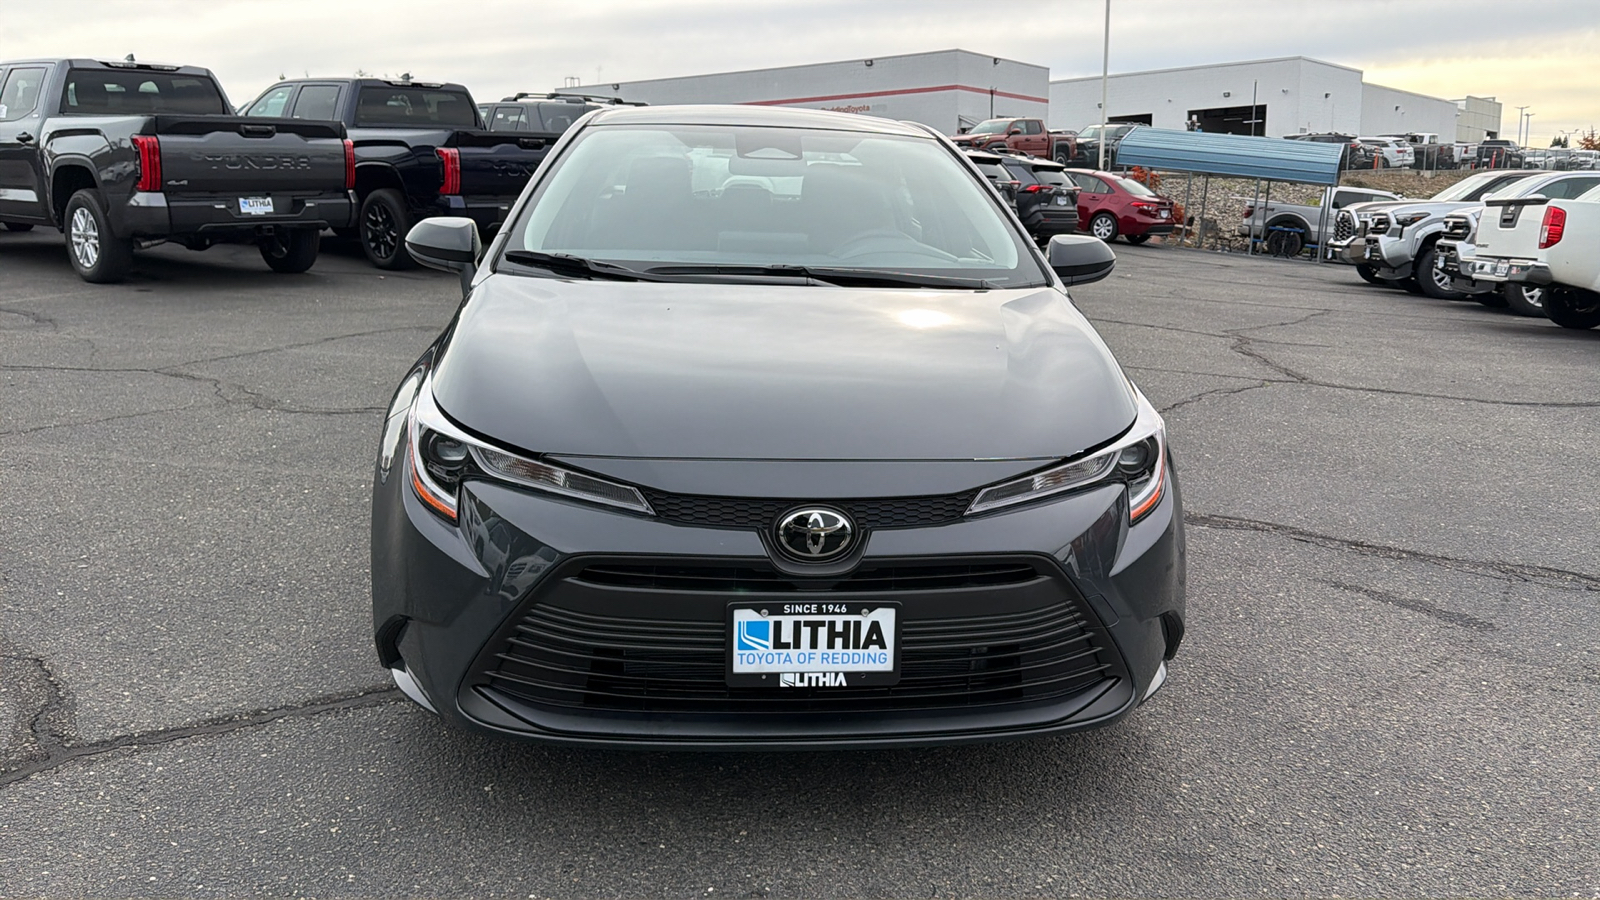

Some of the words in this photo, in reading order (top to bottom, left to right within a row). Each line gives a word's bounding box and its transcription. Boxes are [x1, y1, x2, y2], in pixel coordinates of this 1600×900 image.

[205, 156, 311, 169] TUNDRA
[248, 200, 272, 208] LITHIA
[783, 604, 818, 614] SINCE
[821, 604, 848, 613] 1946
[772, 620, 888, 650] LITHIA
[737, 652, 793, 665] TOYOTA
[797, 652, 816, 665] OF
[820, 652, 888, 665] REDDING
[795, 672, 848, 687] LITHIA
